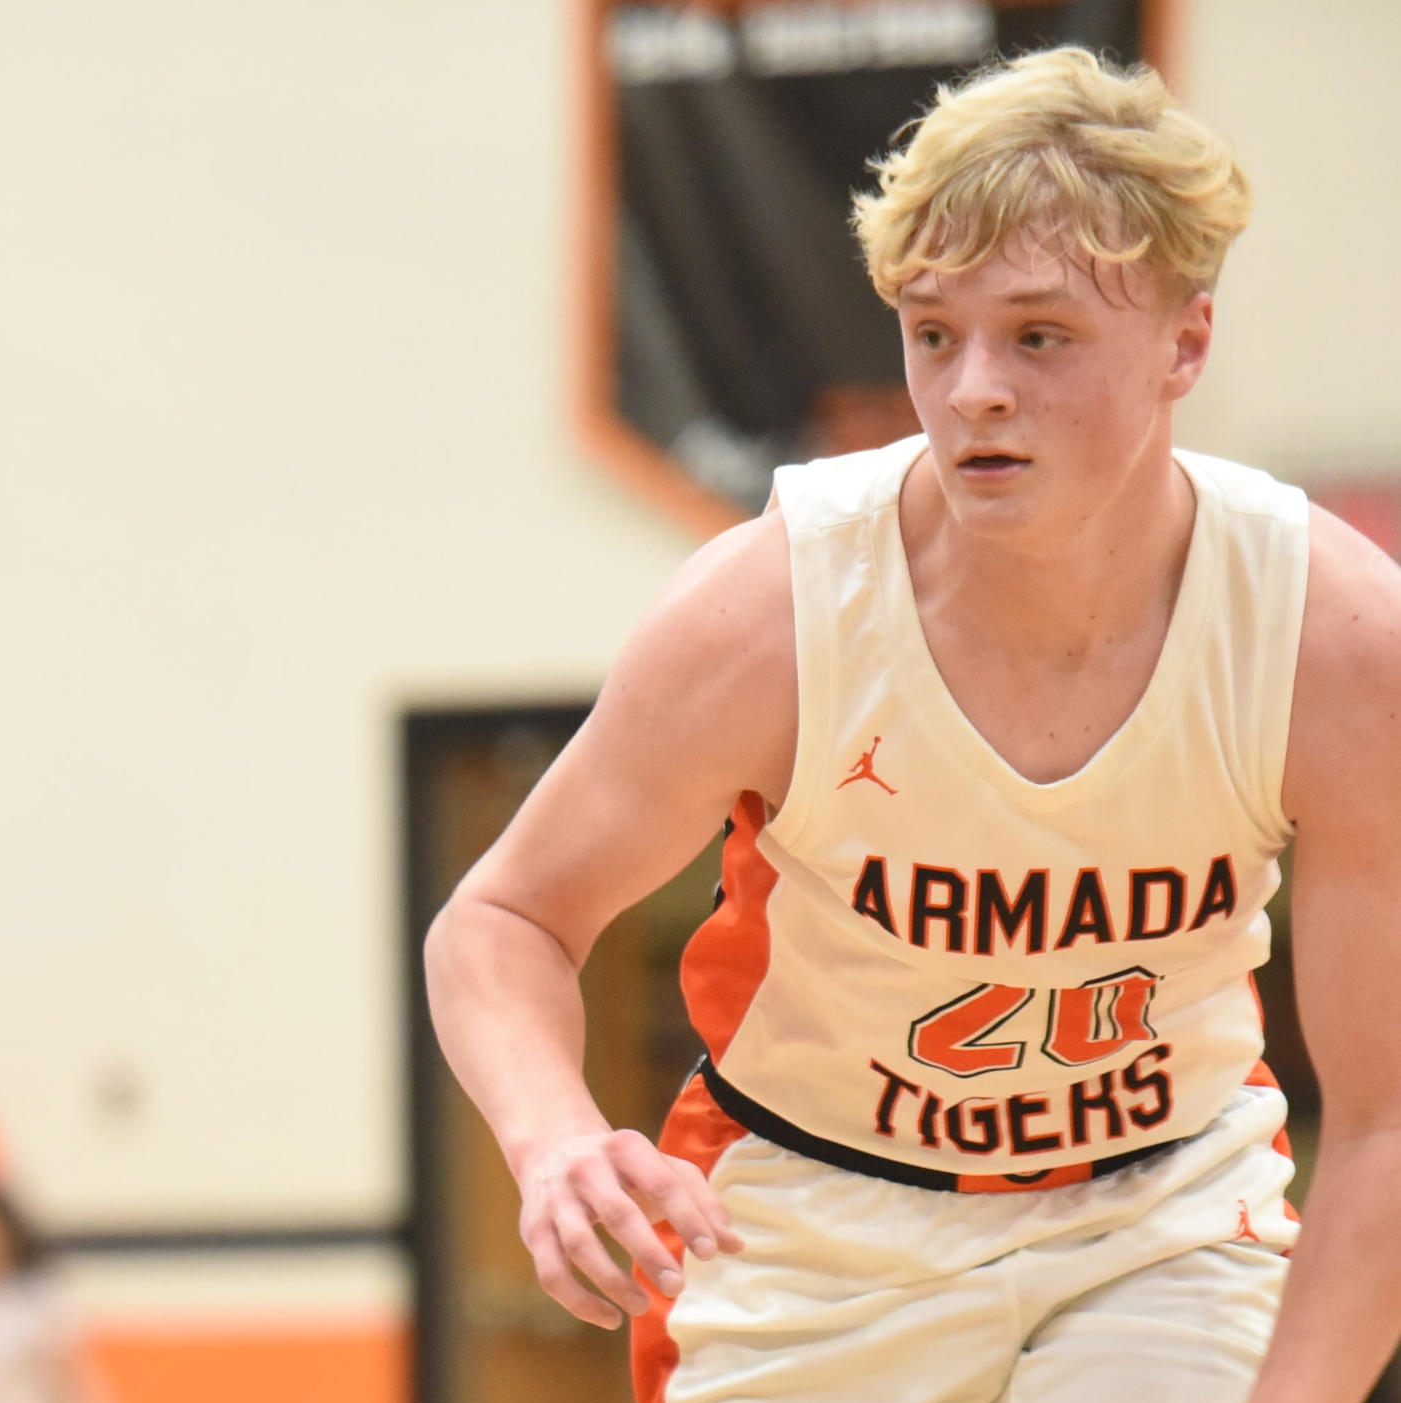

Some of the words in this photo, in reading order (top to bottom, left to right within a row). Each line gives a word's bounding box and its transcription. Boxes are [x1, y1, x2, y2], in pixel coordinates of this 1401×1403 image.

[850, 852, 1239, 957] ARMADA
[907, 965, 1165, 1079] 20
[869, 1042, 1174, 1157] TIGERS
